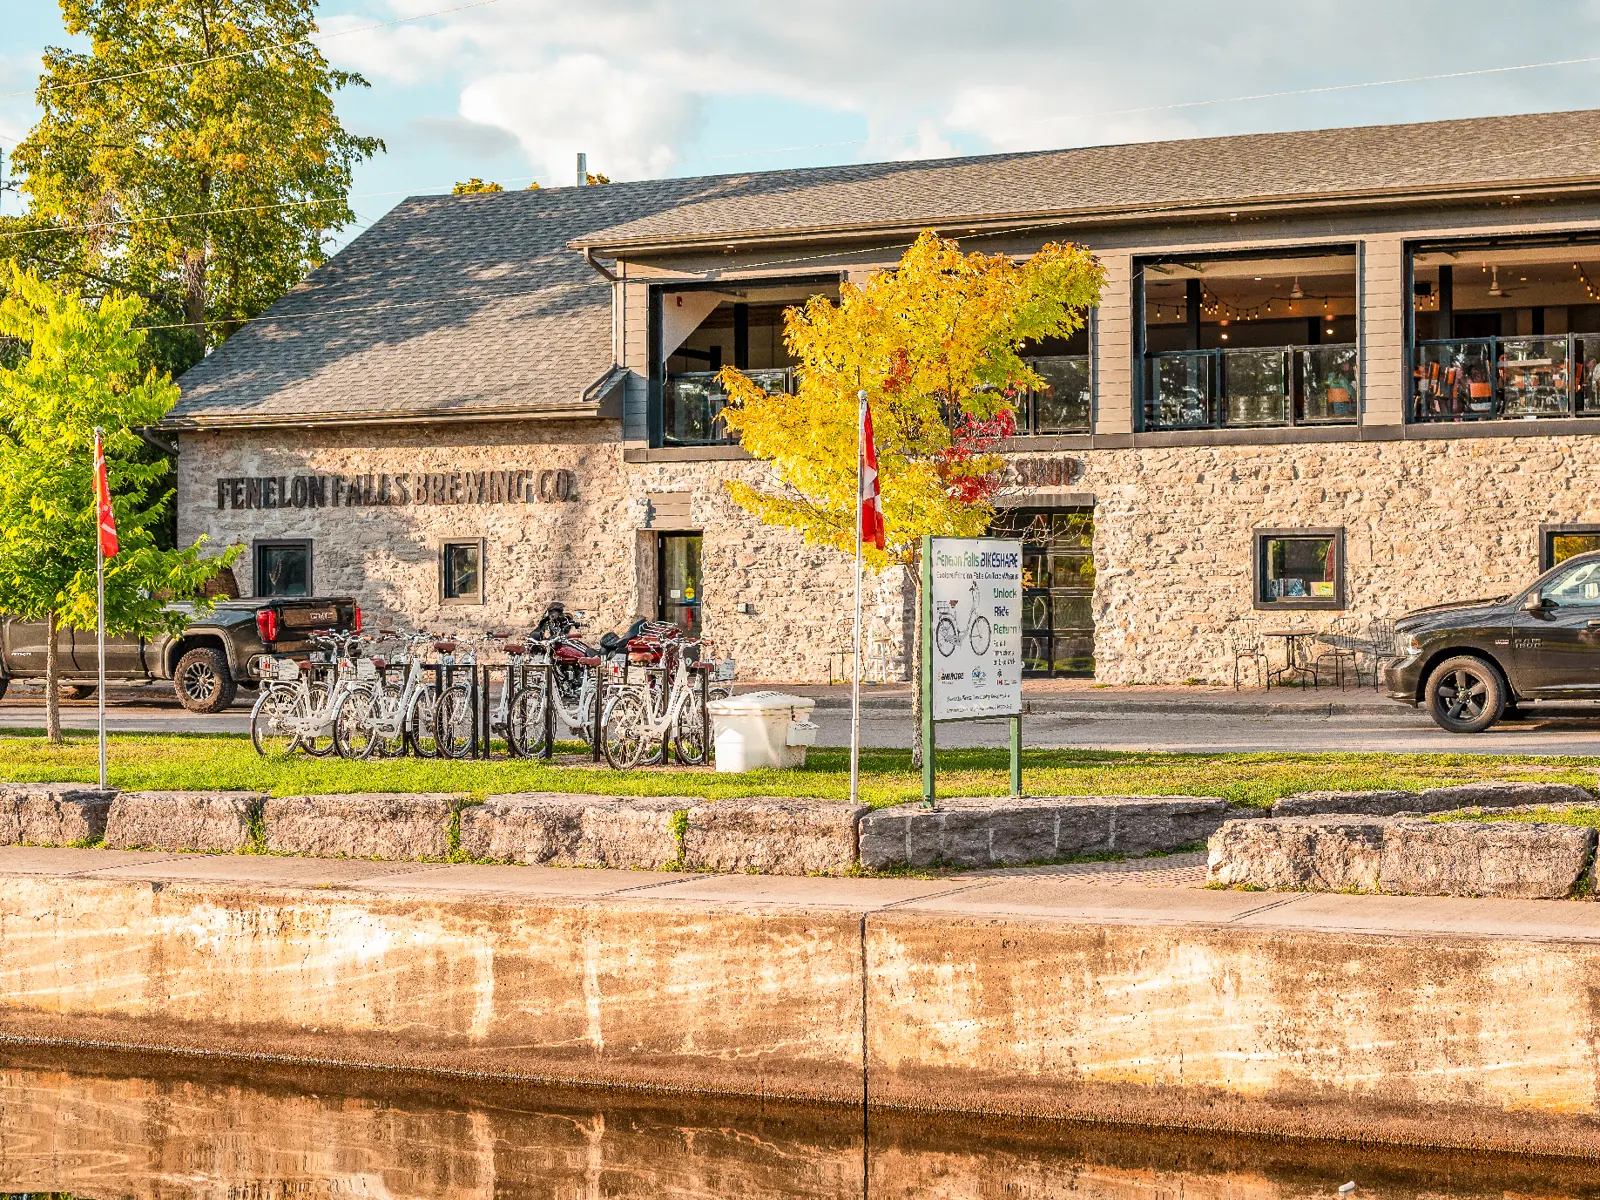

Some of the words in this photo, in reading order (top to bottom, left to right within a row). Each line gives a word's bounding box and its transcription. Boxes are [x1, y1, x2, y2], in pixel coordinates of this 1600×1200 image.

[1015, 456, 1078, 487] SHOP
[217, 475, 325, 510] FENELON
[331, 473, 407, 507] FALLS
[412, 470, 530, 506] BREWING
[963, 551, 980, 568] Falls
[980, 552, 1018, 568] BIKESHARE
[993, 588, 1017, 598] Unlock
[994, 606, 1009, 617] Ride
[993, 624, 1017, 635] Return
